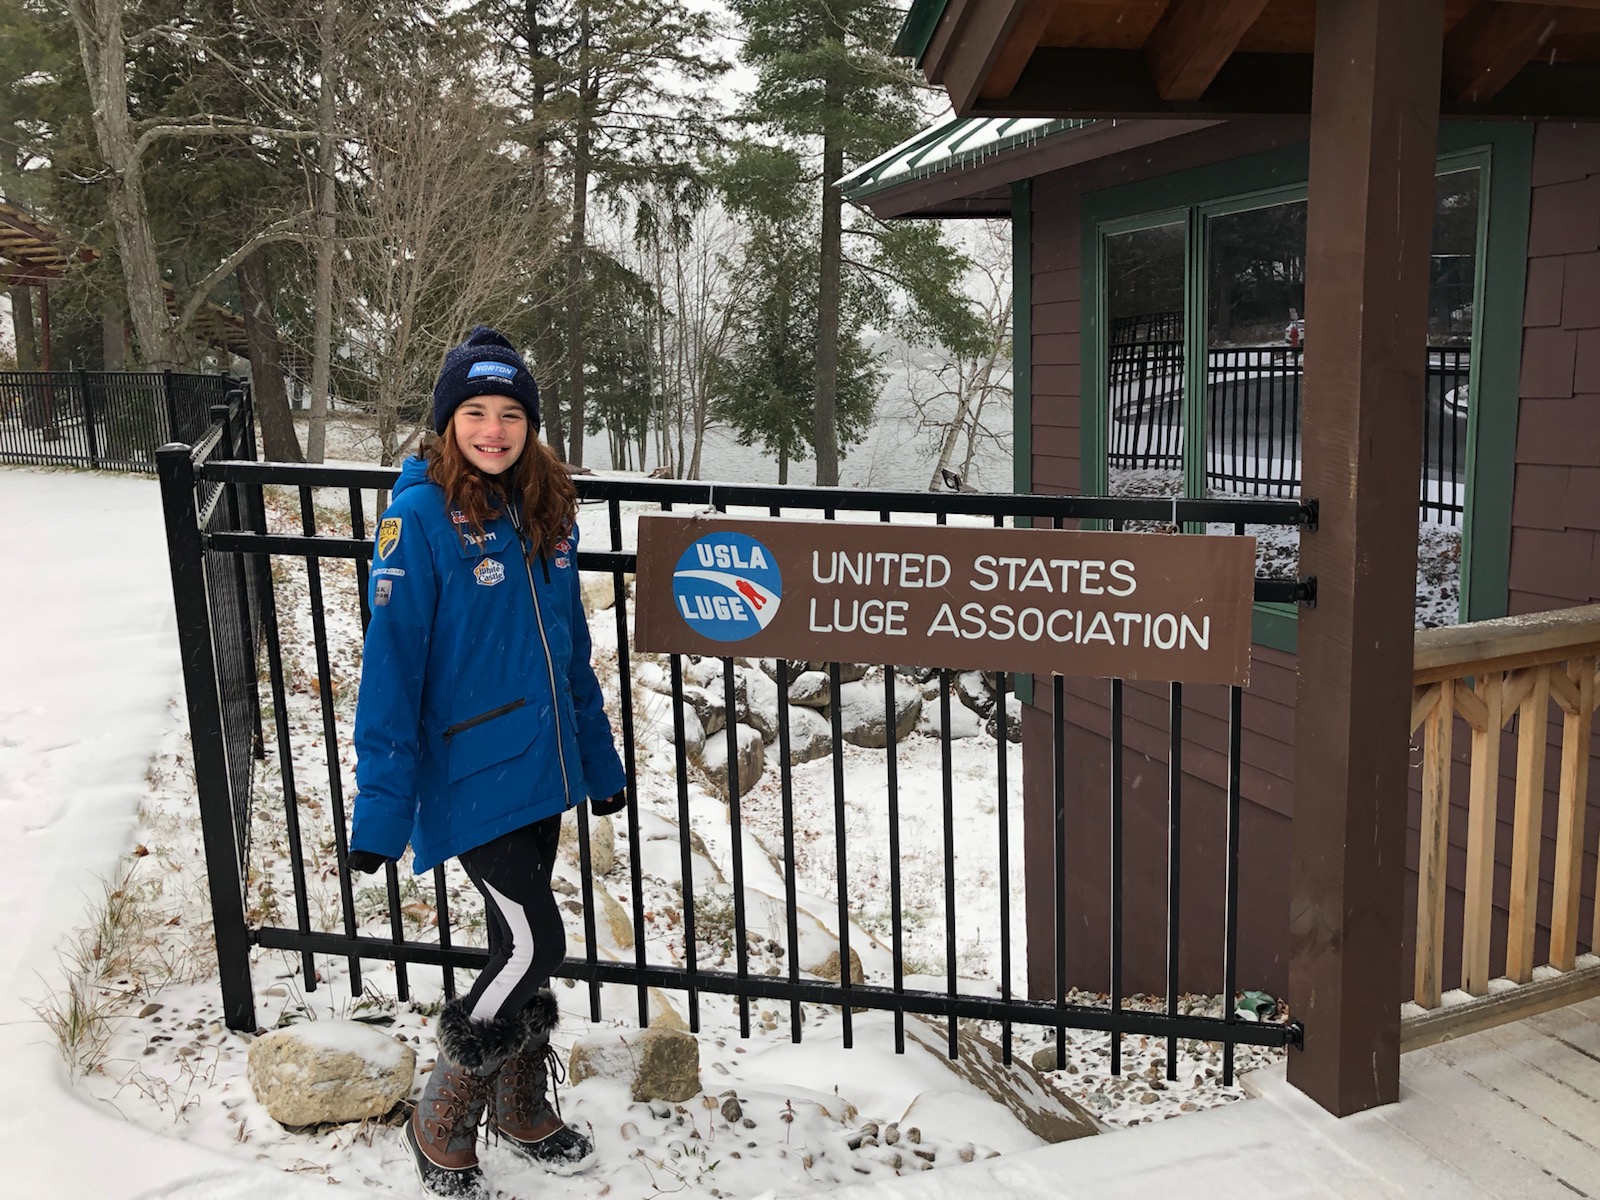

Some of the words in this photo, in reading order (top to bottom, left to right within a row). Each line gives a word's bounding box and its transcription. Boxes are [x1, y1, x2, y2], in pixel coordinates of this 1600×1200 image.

[474, 365, 513, 375] NORTON
[696, 543, 769, 570] USLA
[478, 573, 504, 584] Castle
[479, 566, 501, 576] White
[811, 550, 952, 589] UNITED
[969, 554, 1138, 597] STATES
[678, 595, 749, 621] LUGE
[808, 597, 910, 636] LUGE
[926, 602, 1211, 651] ASSOCIATION
